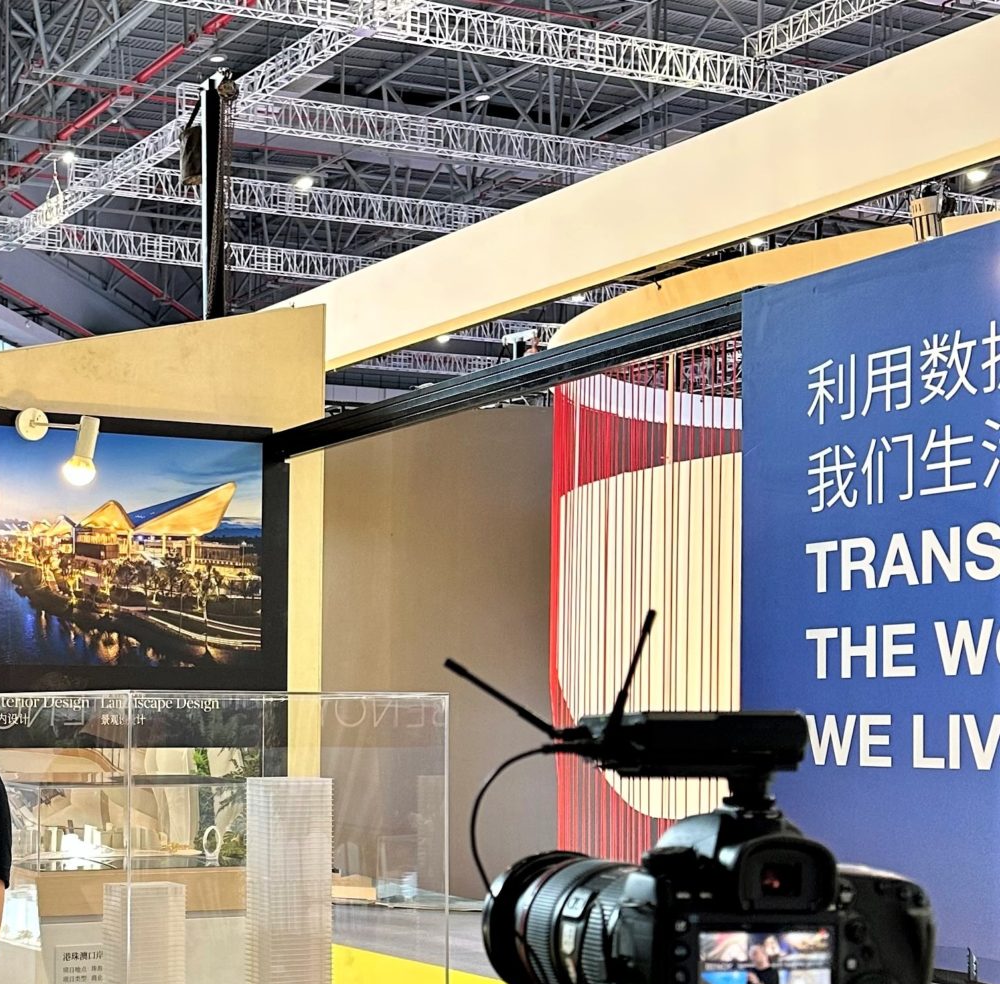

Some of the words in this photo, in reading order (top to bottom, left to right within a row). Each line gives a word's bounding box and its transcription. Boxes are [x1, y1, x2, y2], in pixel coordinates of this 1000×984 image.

[806, 522, 1000, 593] TRANS
[806, 622, 916, 680] THE
[934, 618, 1000, 676] W
[43, 696, 90, 711] Design
[176, 697, 220, 712] Design
[805, 714, 892, 768] WE
[912, 714, 1000, 771] LIV
